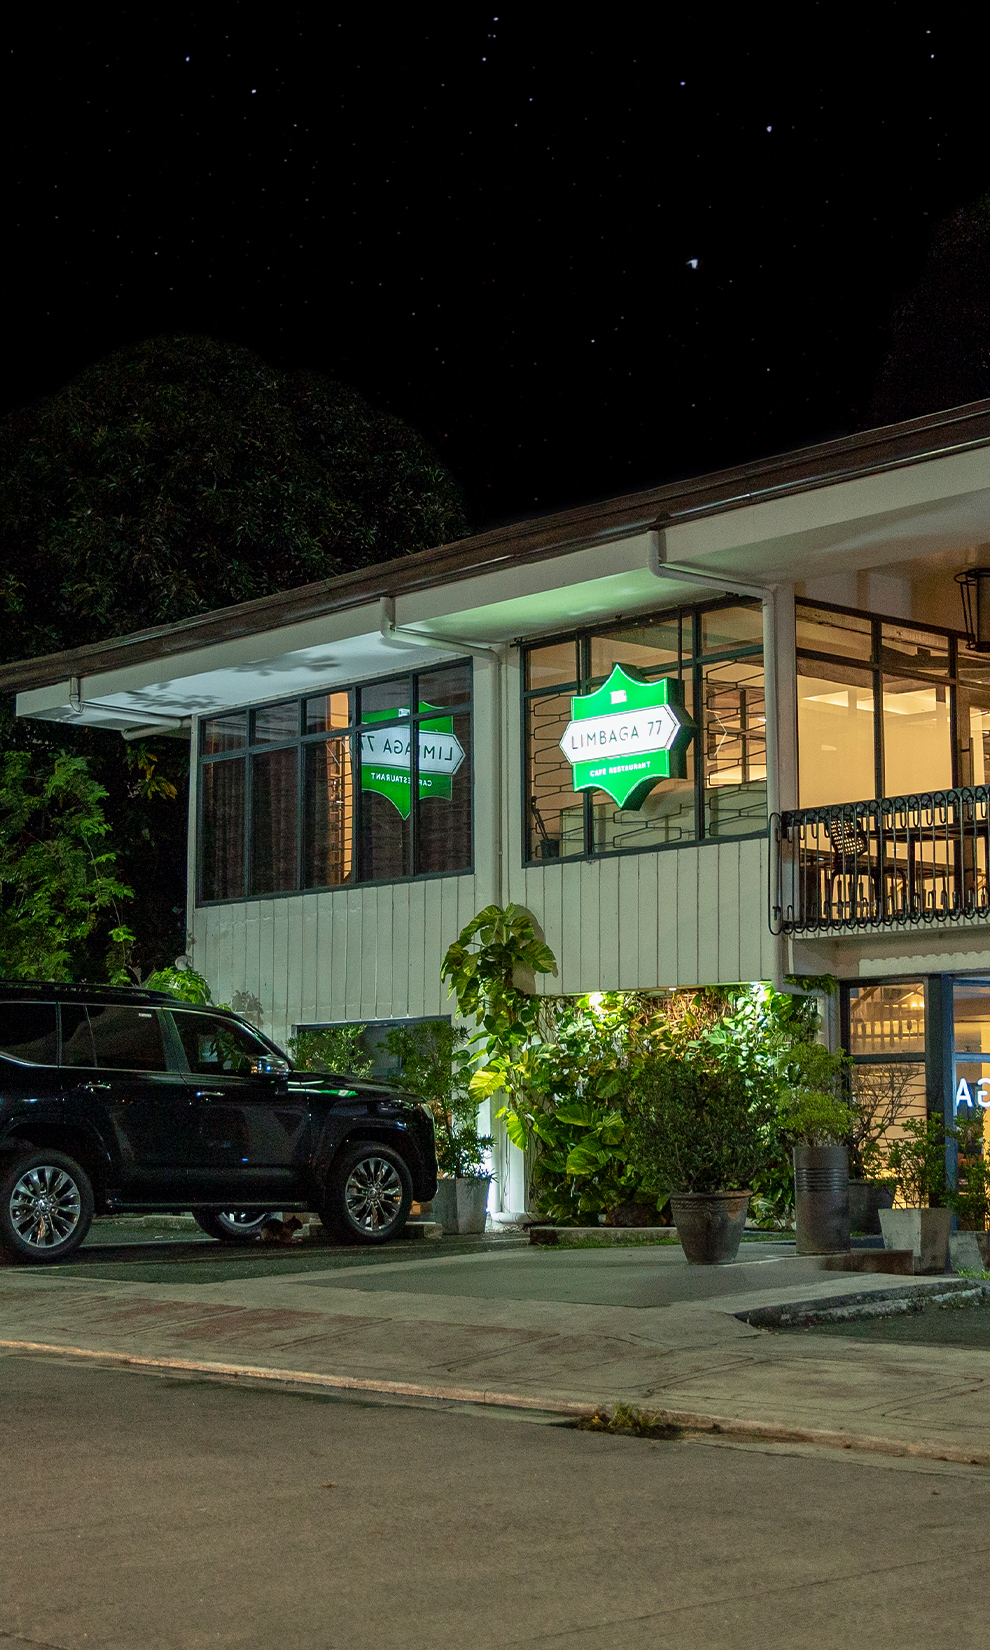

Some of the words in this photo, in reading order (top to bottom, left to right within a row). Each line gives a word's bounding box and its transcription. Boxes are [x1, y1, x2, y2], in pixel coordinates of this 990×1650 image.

[571, 725, 640, 750] LIMBAGA
[647, 720, 663, 737] 77
[590, 768, 607, 777] CAFE
[609, 761, 651, 774] RESTAURANT
